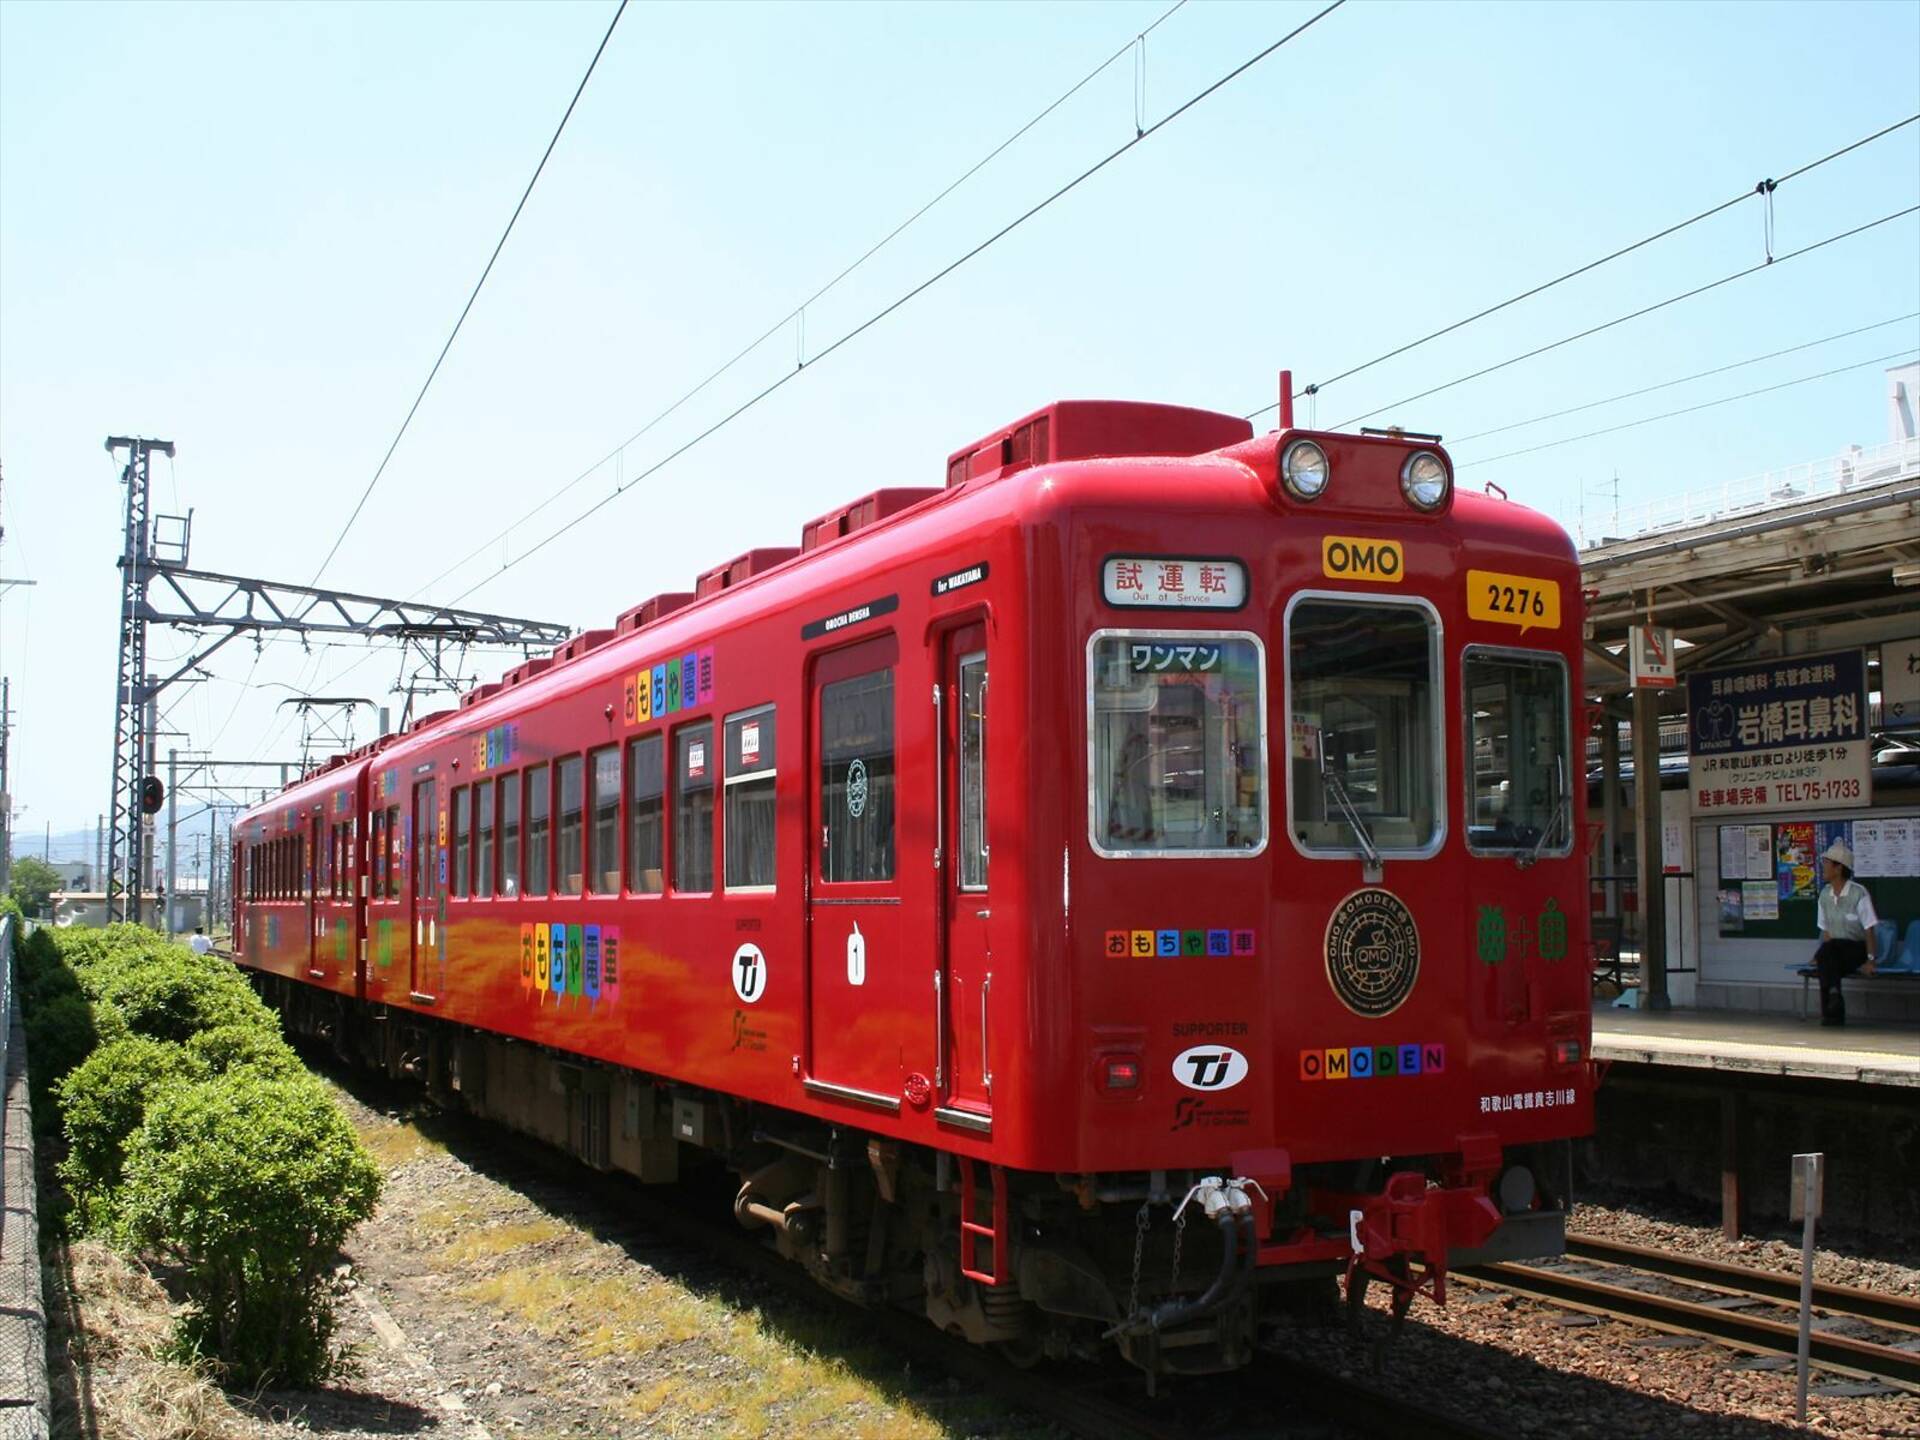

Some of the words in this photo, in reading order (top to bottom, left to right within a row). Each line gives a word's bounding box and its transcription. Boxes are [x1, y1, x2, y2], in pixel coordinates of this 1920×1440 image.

[1327, 542, 1399, 576] OMO
[948, 567, 982, 589] WAKAYAMA
[1116, 562, 1226, 594] 試運転
[1132, 592, 1149, 602] Out
[1177, 593, 1210, 603] Service
[1488, 584, 1545, 618] 2276
[1132, 645, 1219, 671] ワンマン
[1737, 692, 1858, 745] 岩橋耳鼻科
[1698, 785, 1768, 808] 駐車場完備
[1347, 894, 1400, 914] OMODEN
[1107, 931, 1253, 956] おもちゃ電車
[1329, 926, 1341, 957] OMO
[1359, 949, 1390, 963] OMO
[1173, 1023, 1248, 1037] SUPPORTER
[1303, 1049, 1442, 1076] OMODEN
